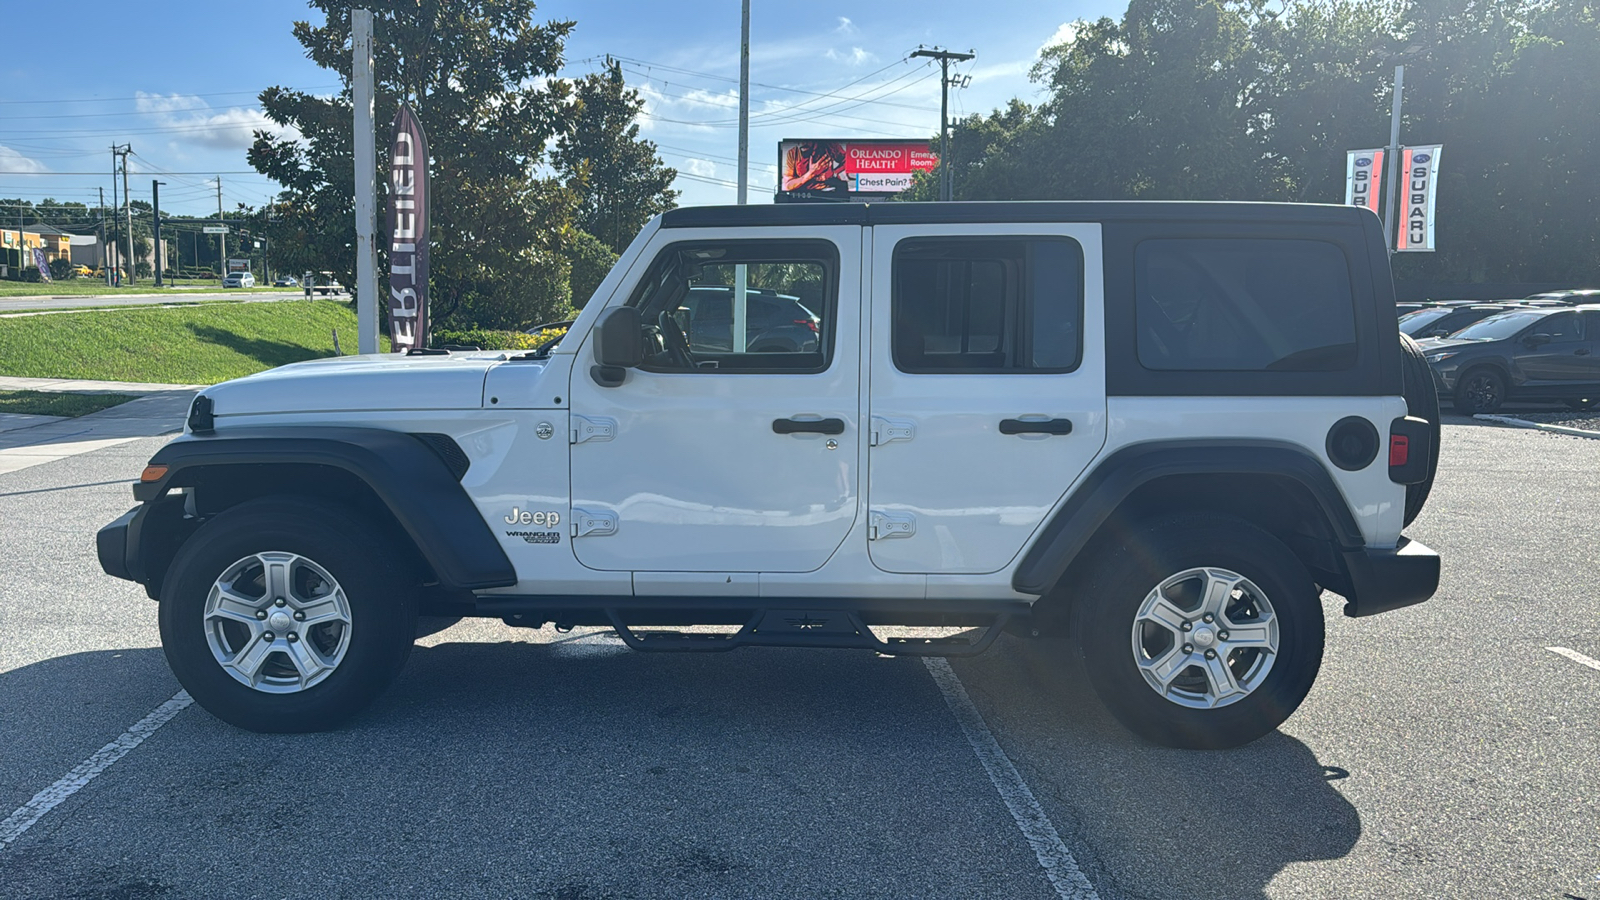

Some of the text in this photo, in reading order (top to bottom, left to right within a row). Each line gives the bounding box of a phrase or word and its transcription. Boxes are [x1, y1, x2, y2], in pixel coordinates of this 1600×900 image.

[850, 149, 901, 159] ORLANDO
[856, 159, 896, 169] HEALTH
[859, 178, 907, 187] Chest Pain?
[1409, 167, 1427, 244] SUBARU
[504, 506, 560, 529] Jeep
